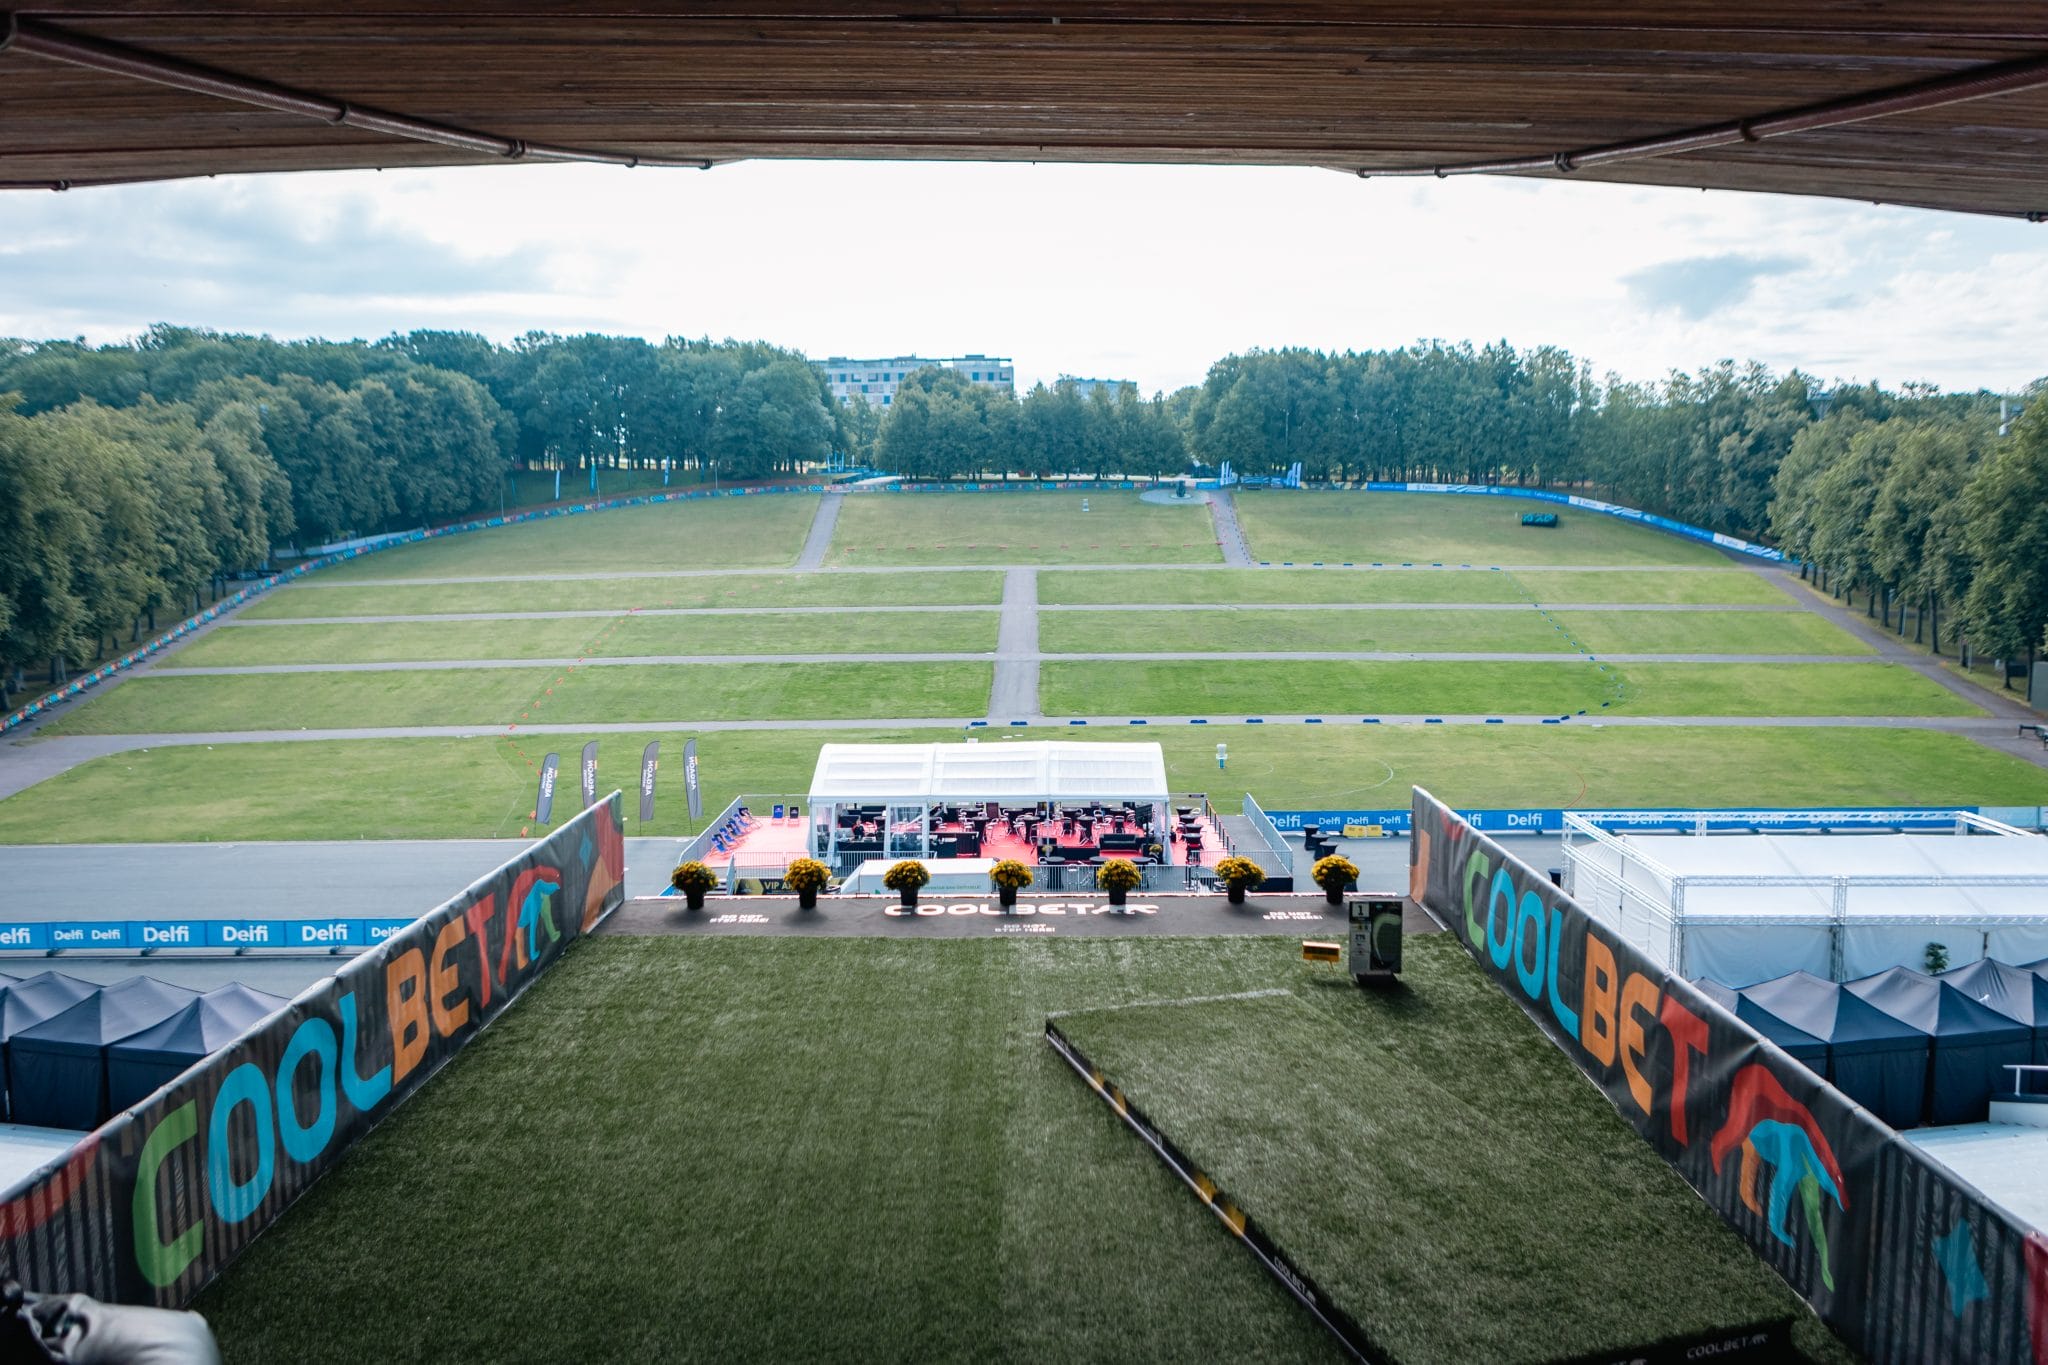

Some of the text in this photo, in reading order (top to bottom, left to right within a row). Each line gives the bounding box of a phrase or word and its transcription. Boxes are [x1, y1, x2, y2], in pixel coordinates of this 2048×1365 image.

[1319, 816, 1340, 825] Delfi
[1347, 816, 1369, 825] Delfi
[1379, 816, 1401, 824] Delfi
[1507, 813, 1542, 826] Delfi
[764, 881, 780, 890] VIP
[884, 904, 1094, 916] COOLBET
[0, 928, 31, 944] elfi
[54, 930, 84, 941] Delfi
[91, 930, 121, 941] Delfi
[143, 926, 190, 943] Delfi
[222, 925, 269, 942] Delfi
[302, 924, 348, 941] Delfi
[1463, 850, 1710, 1147] COOLBET
[133, 891, 496, 1288] COOLBET
[1686, 1336, 1749, 1359] COOLBET
